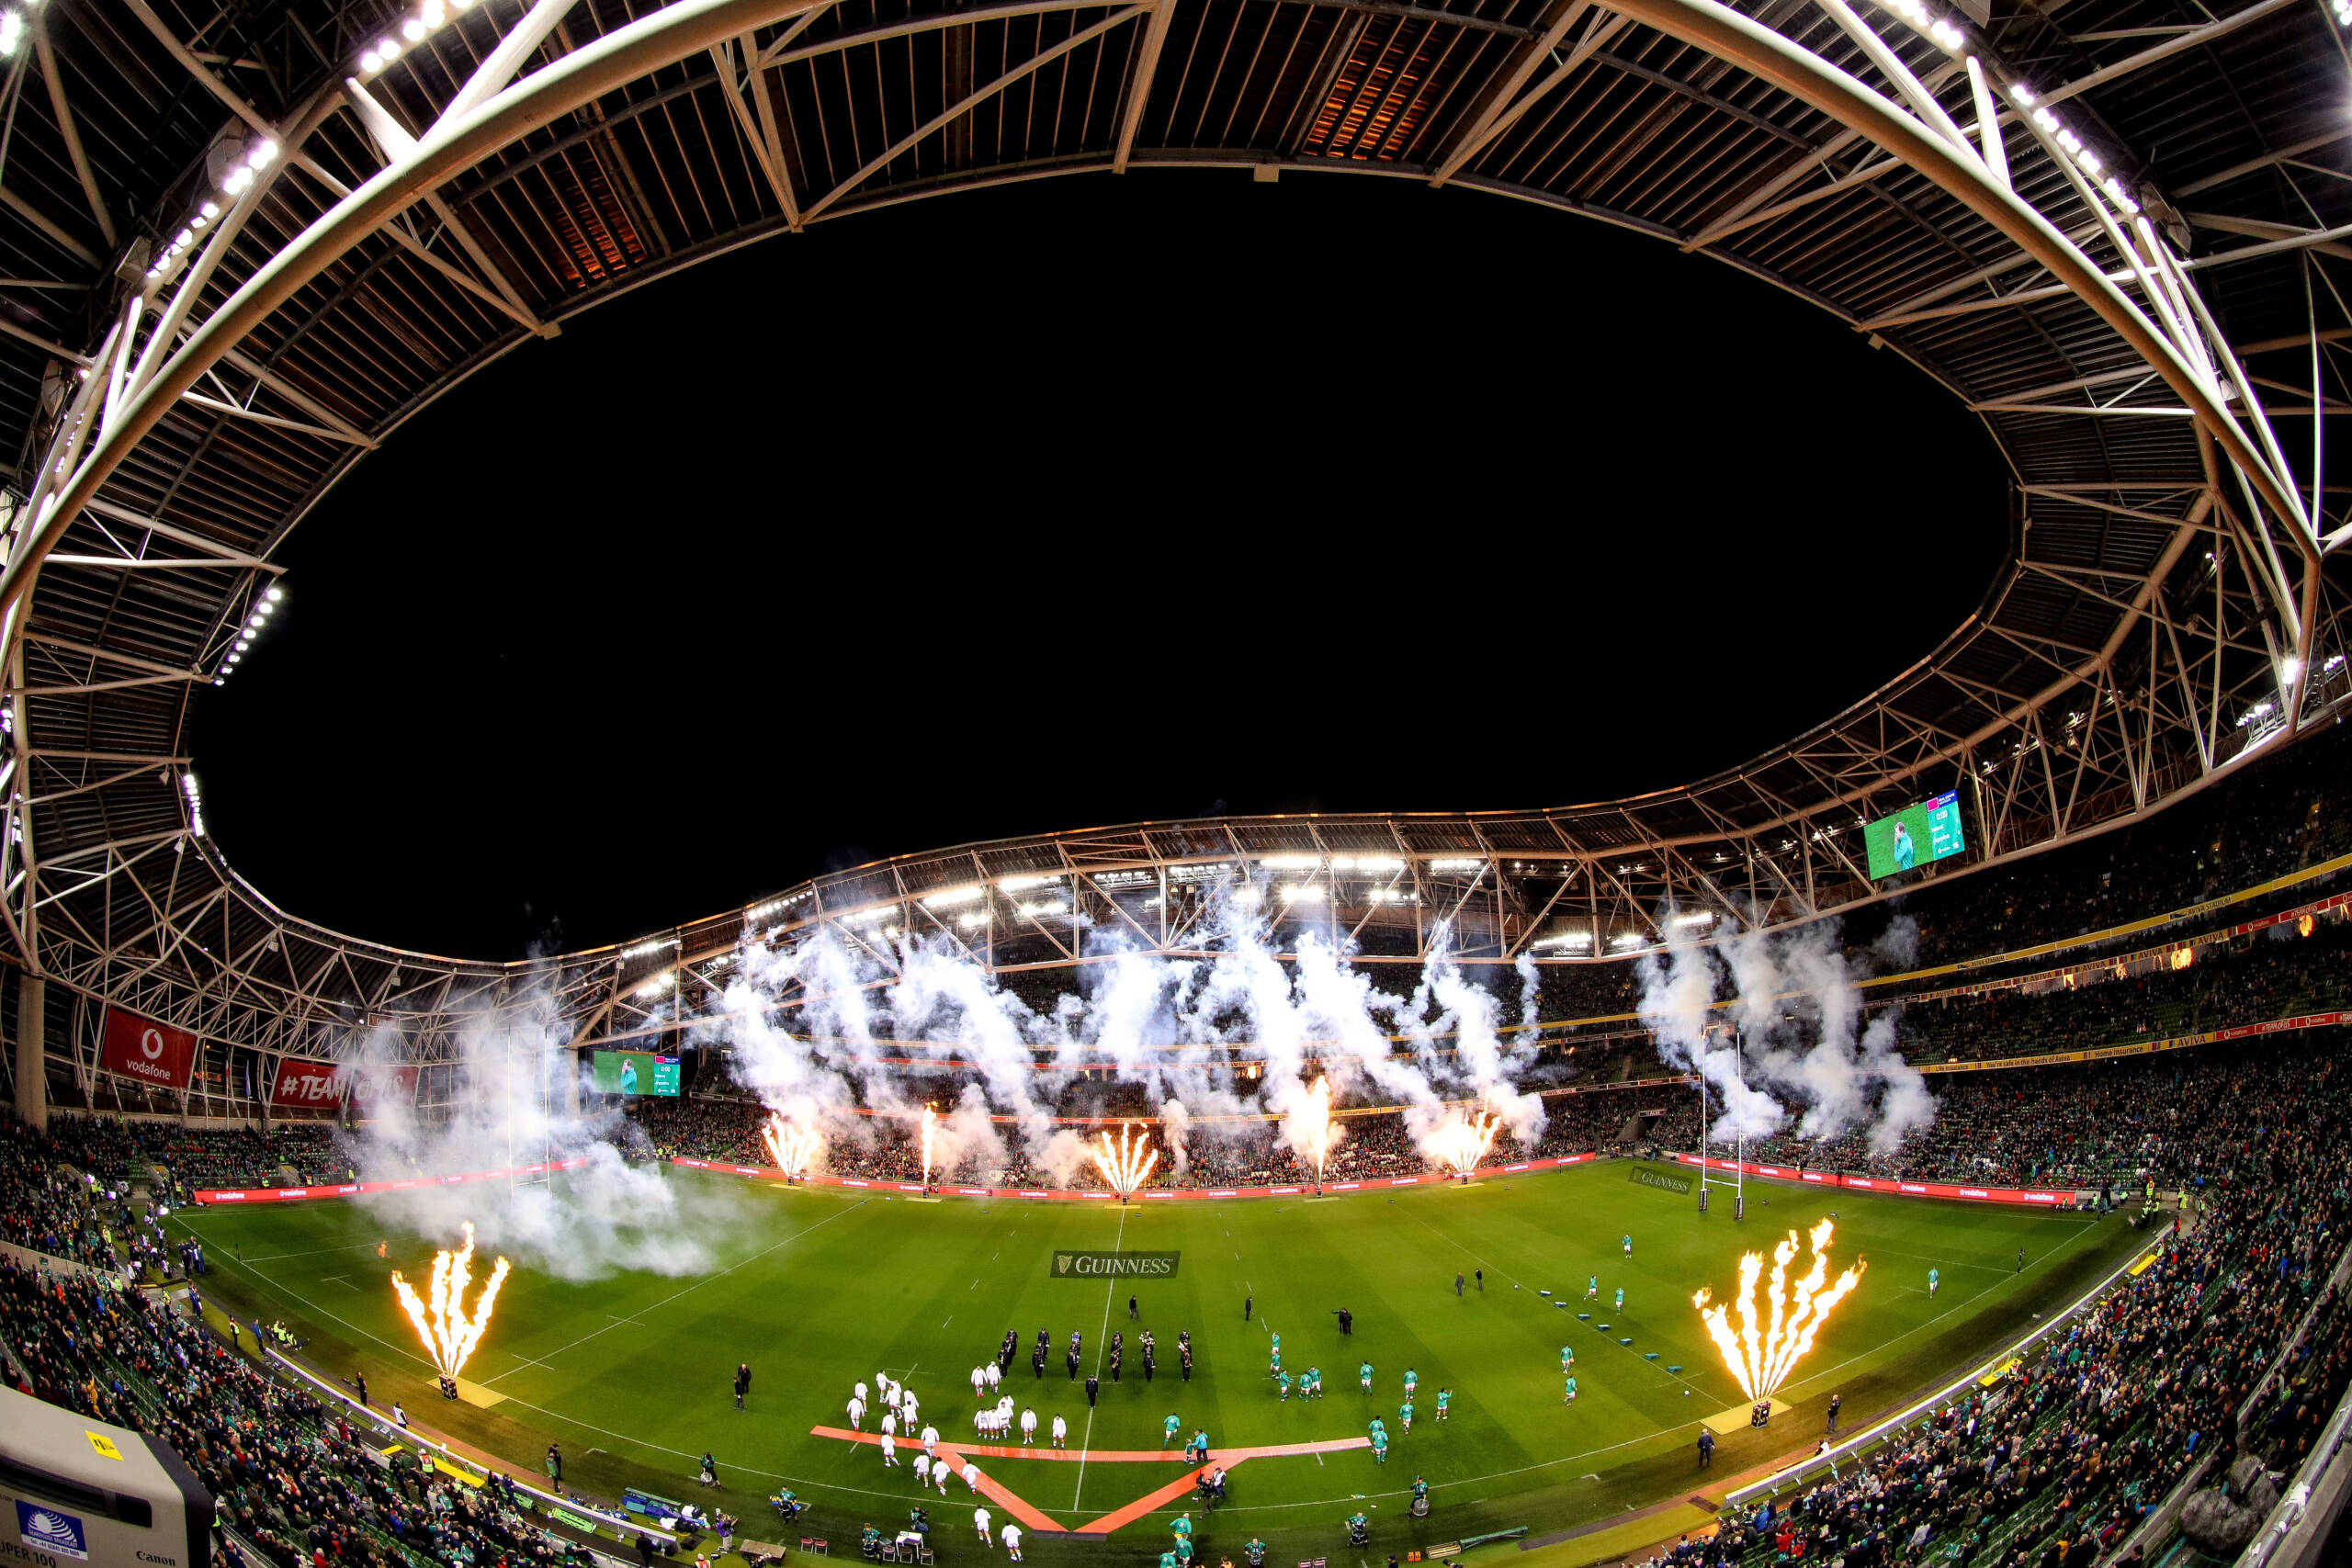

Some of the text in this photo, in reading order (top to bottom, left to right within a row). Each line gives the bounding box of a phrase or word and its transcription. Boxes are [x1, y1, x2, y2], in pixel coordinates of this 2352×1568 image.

[2188, 897, 2232, 915] AVIVA STADIUM
[2198, 931, 2223, 944] AVIVA
[2138, 947, 2164, 958] AVIVA
[2083, 961, 2106, 971] AVIVA
[2030, 972, 2052, 981] AVIVA
[1982, 981, 2001, 990] AVIVA
[1936, 990, 1954, 998] AVIVA
[2177, 1035, 2205, 1047] AVIVA
[2113, 1046, 2143, 1055] Insurance
[127, 1059, 171, 1080] vodafone
[280, 1075, 347, 1103] #TEAM
[1641, 1170, 1690, 1191] GUINNESS
[1964, 1189, 1987, 1197] vodafone
[2029, 1192, 2054, 1201] vodafone
[1075, 1256, 1171, 1274] GUINNESS
[32, 1551, 57, 1568] 100
[136, 1551, 175, 1567] Canon
